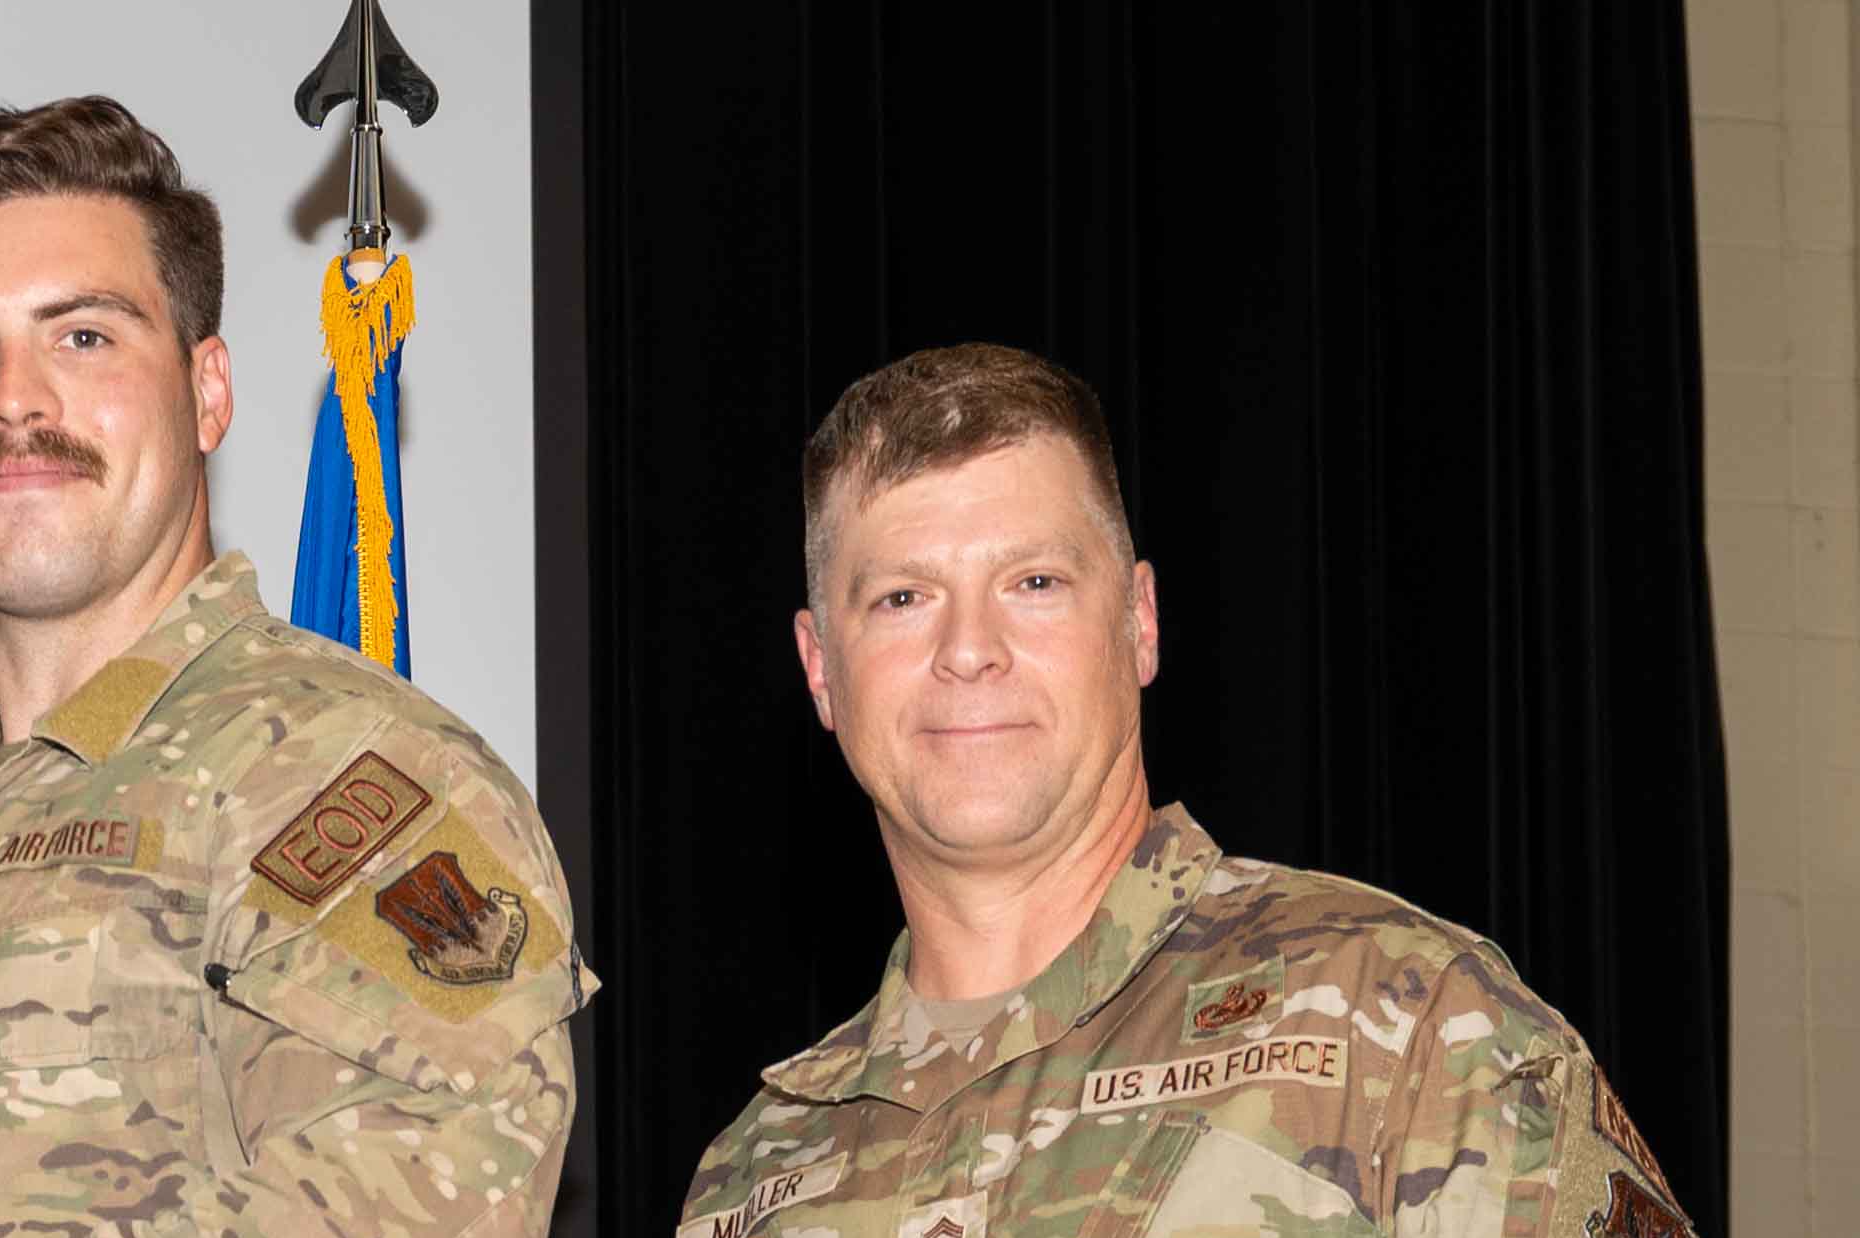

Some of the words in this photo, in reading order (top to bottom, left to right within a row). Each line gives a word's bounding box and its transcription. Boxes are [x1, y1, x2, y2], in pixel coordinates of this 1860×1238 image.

[43, 820, 129, 859] FORCE
[279, 779, 397, 882] EOD
[1157, 1059, 1215, 1096] AIR
[1224, 1041, 1339, 1082] FORCE
